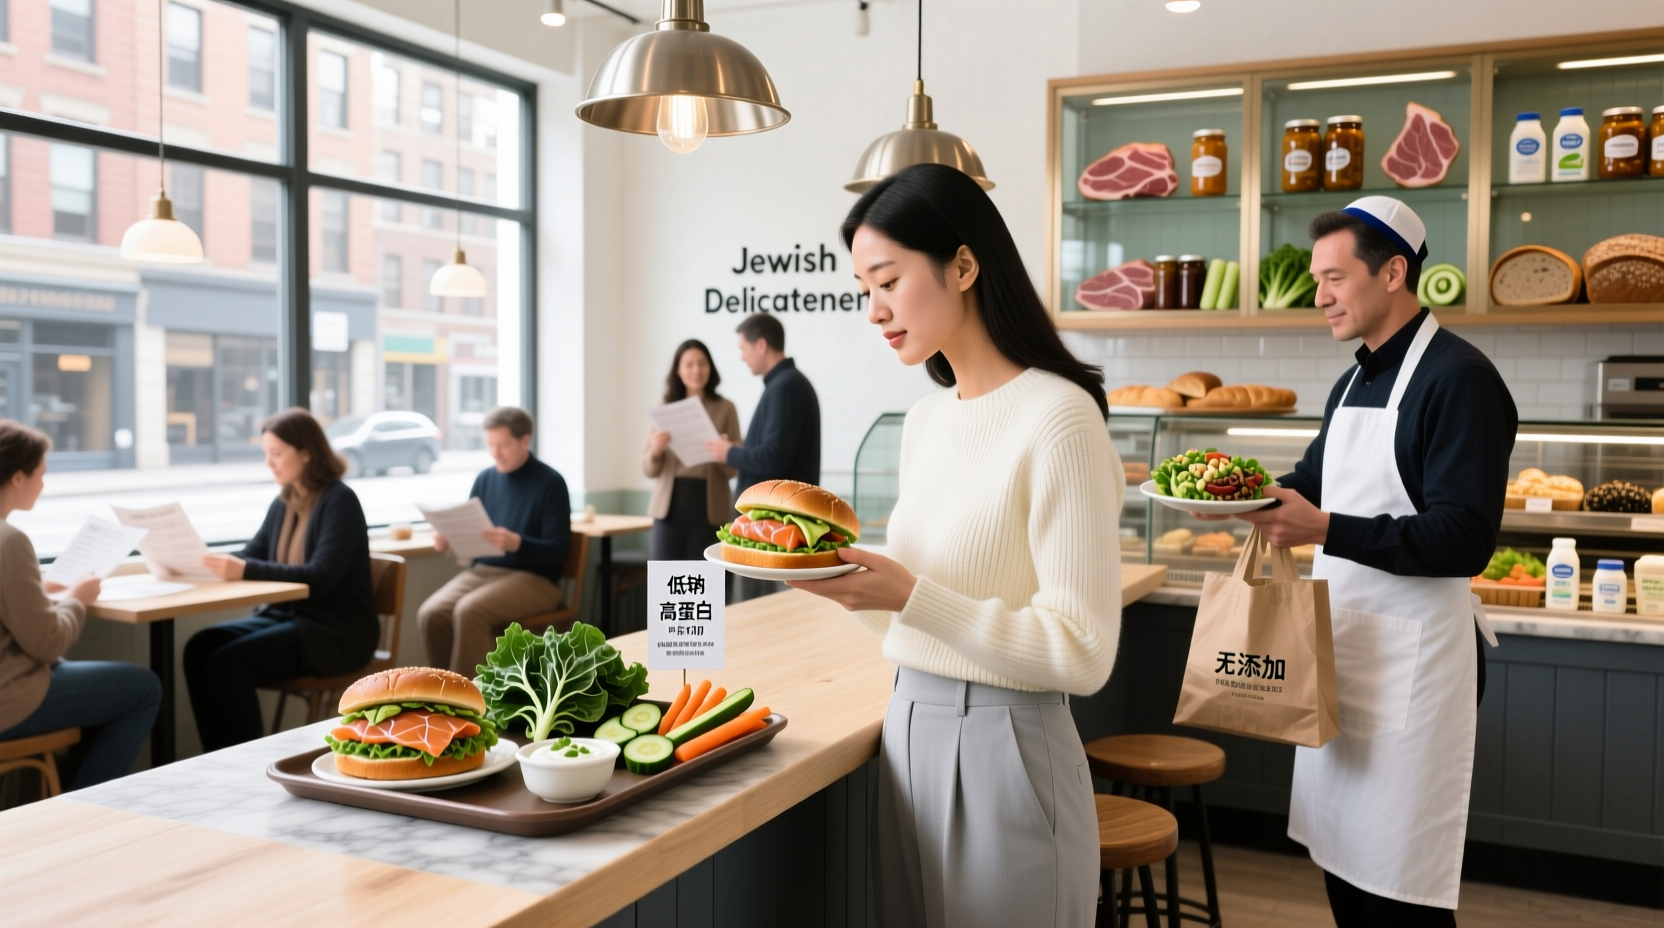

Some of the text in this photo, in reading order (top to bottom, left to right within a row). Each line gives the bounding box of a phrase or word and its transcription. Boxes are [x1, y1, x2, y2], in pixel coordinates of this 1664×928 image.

[732, 243, 836, 274] Jewish
[659, 600, 712, 621] 高蛋白
[1214, 651, 1286, 681] 无添加
